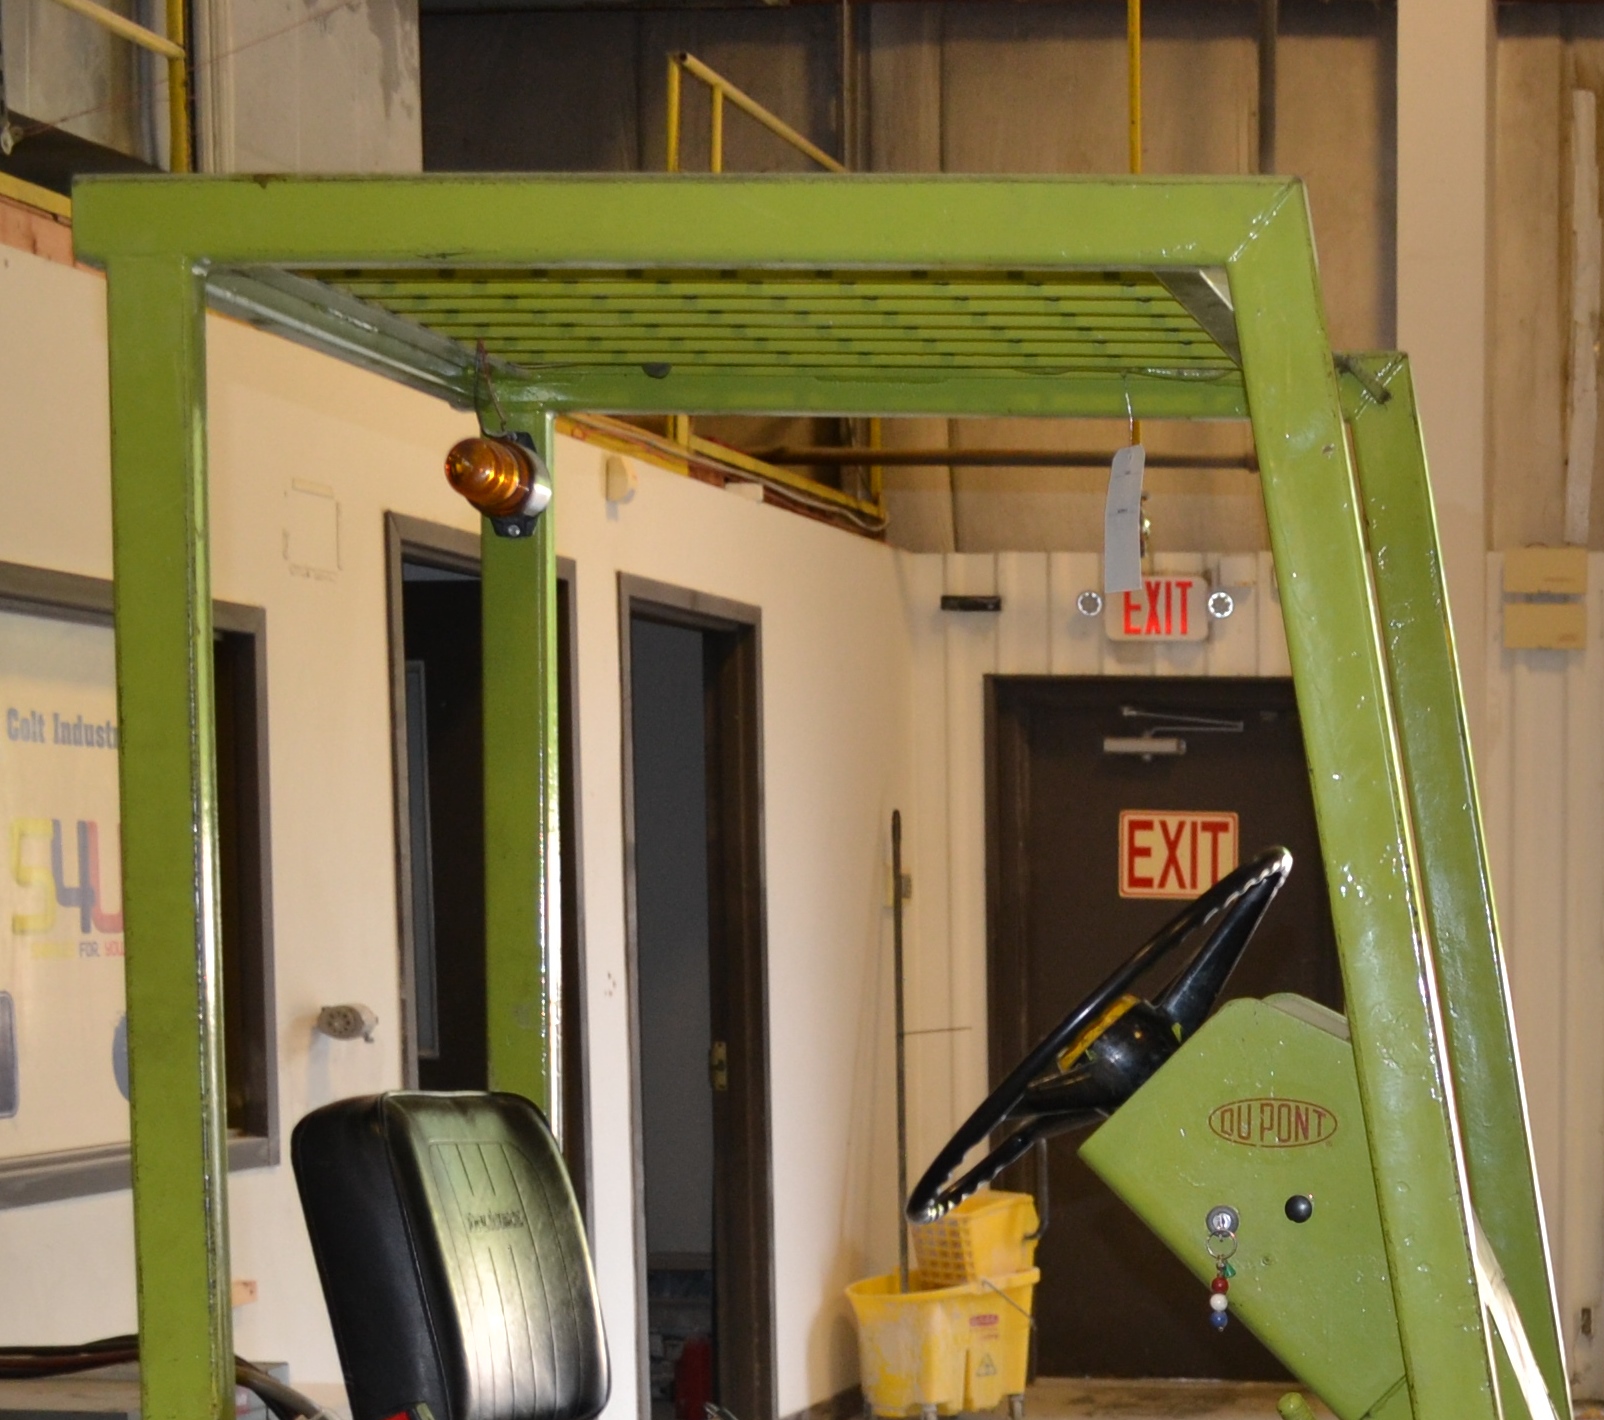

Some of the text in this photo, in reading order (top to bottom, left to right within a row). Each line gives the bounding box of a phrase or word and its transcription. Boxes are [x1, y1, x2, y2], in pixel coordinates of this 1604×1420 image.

[1123, 579, 1193, 636] EXIT
[7, 708, 46, 744] Colt
[1127, 819, 1230, 890] EXIT
[1220, 1102, 1327, 1143] DU PONT
